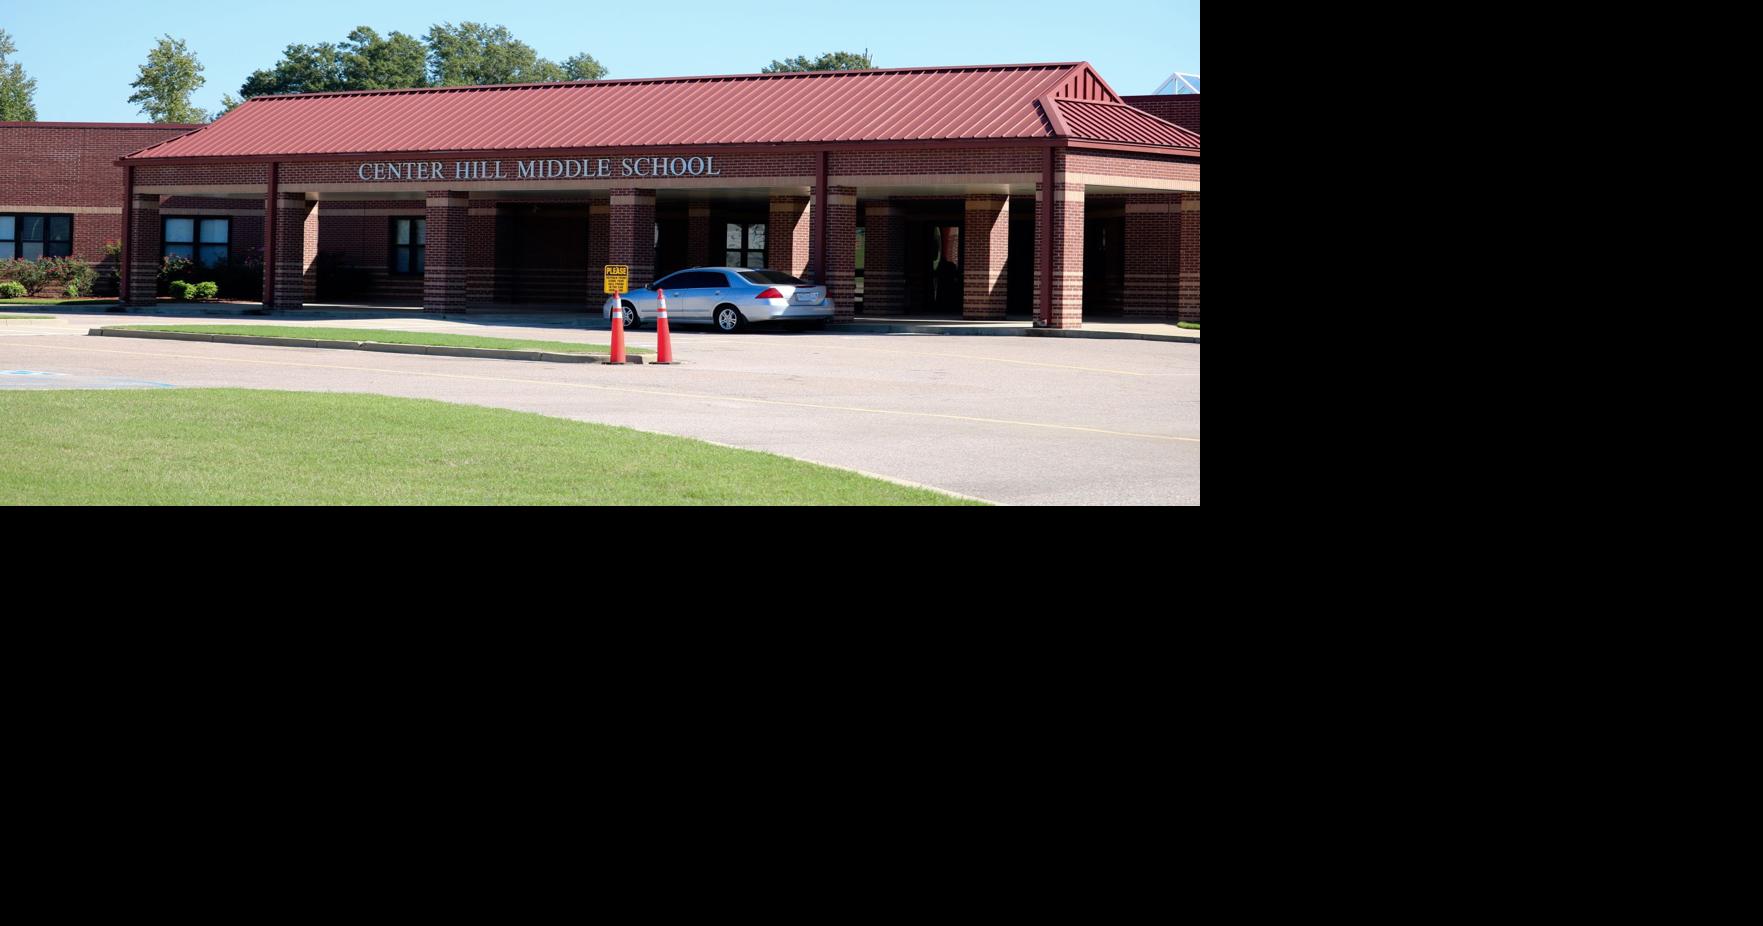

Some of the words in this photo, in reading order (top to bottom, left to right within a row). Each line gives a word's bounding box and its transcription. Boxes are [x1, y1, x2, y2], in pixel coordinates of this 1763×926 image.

[358, 161, 445, 180] CENTER
[455, 160, 507, 179] HILL
[517, 158, 611, 178] MIDDLE
[622, 156, 721, 177] SCHOOL
[606, 267, 626, 275] PLEASE
